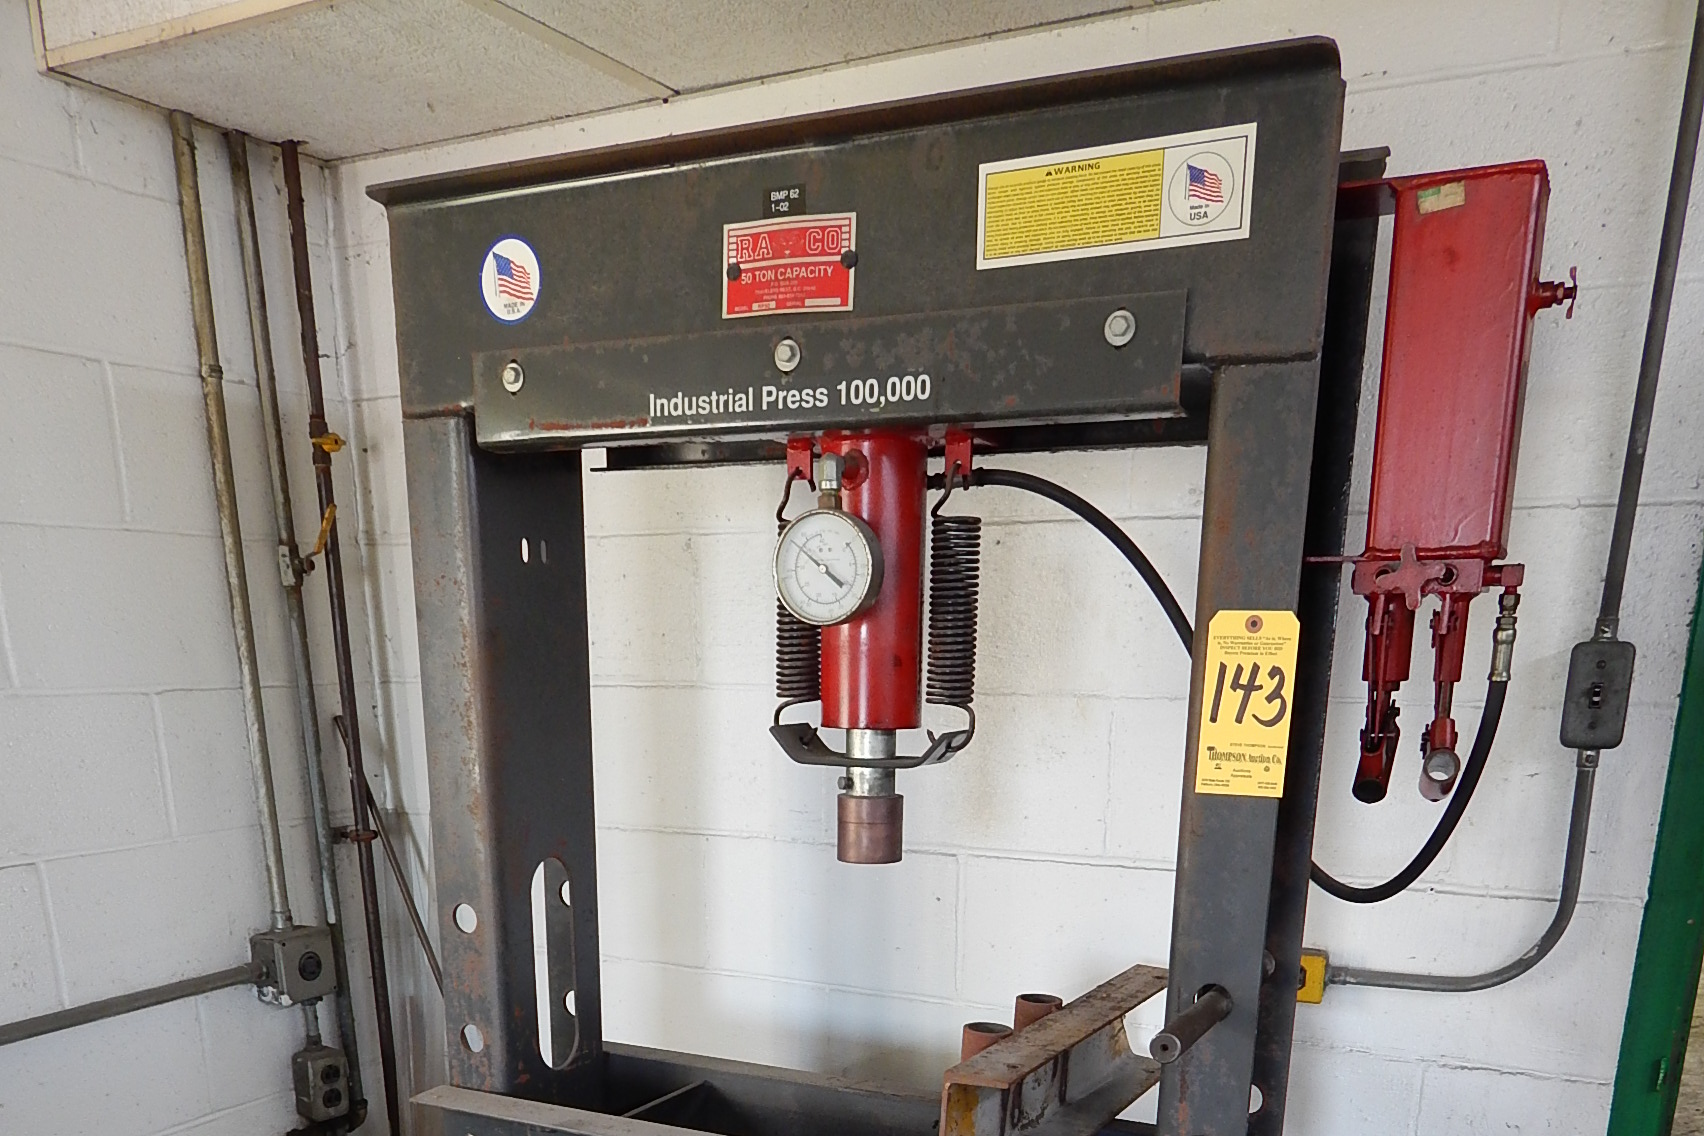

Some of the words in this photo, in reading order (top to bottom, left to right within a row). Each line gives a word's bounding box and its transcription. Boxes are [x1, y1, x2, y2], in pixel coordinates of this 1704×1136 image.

[1053, 162, 1101, 176] WARNING
[771, 190, 788, 201] BMP
[789, 188, 799, 199] 62
[771, 202, 789, 213] 1-02
[1189, 211, 1209, 221] USA
[741, 272, 752, 284] 50
[754, 269, 775, 282] TON
[777, 265, 834, 280] CAPACITY
[650, 386, 753, 417] Industrial
[761, 384, 828, 410] Press
[837, 373, 931, 407] 100,000
[1209, 661, 1287, 728] 143
